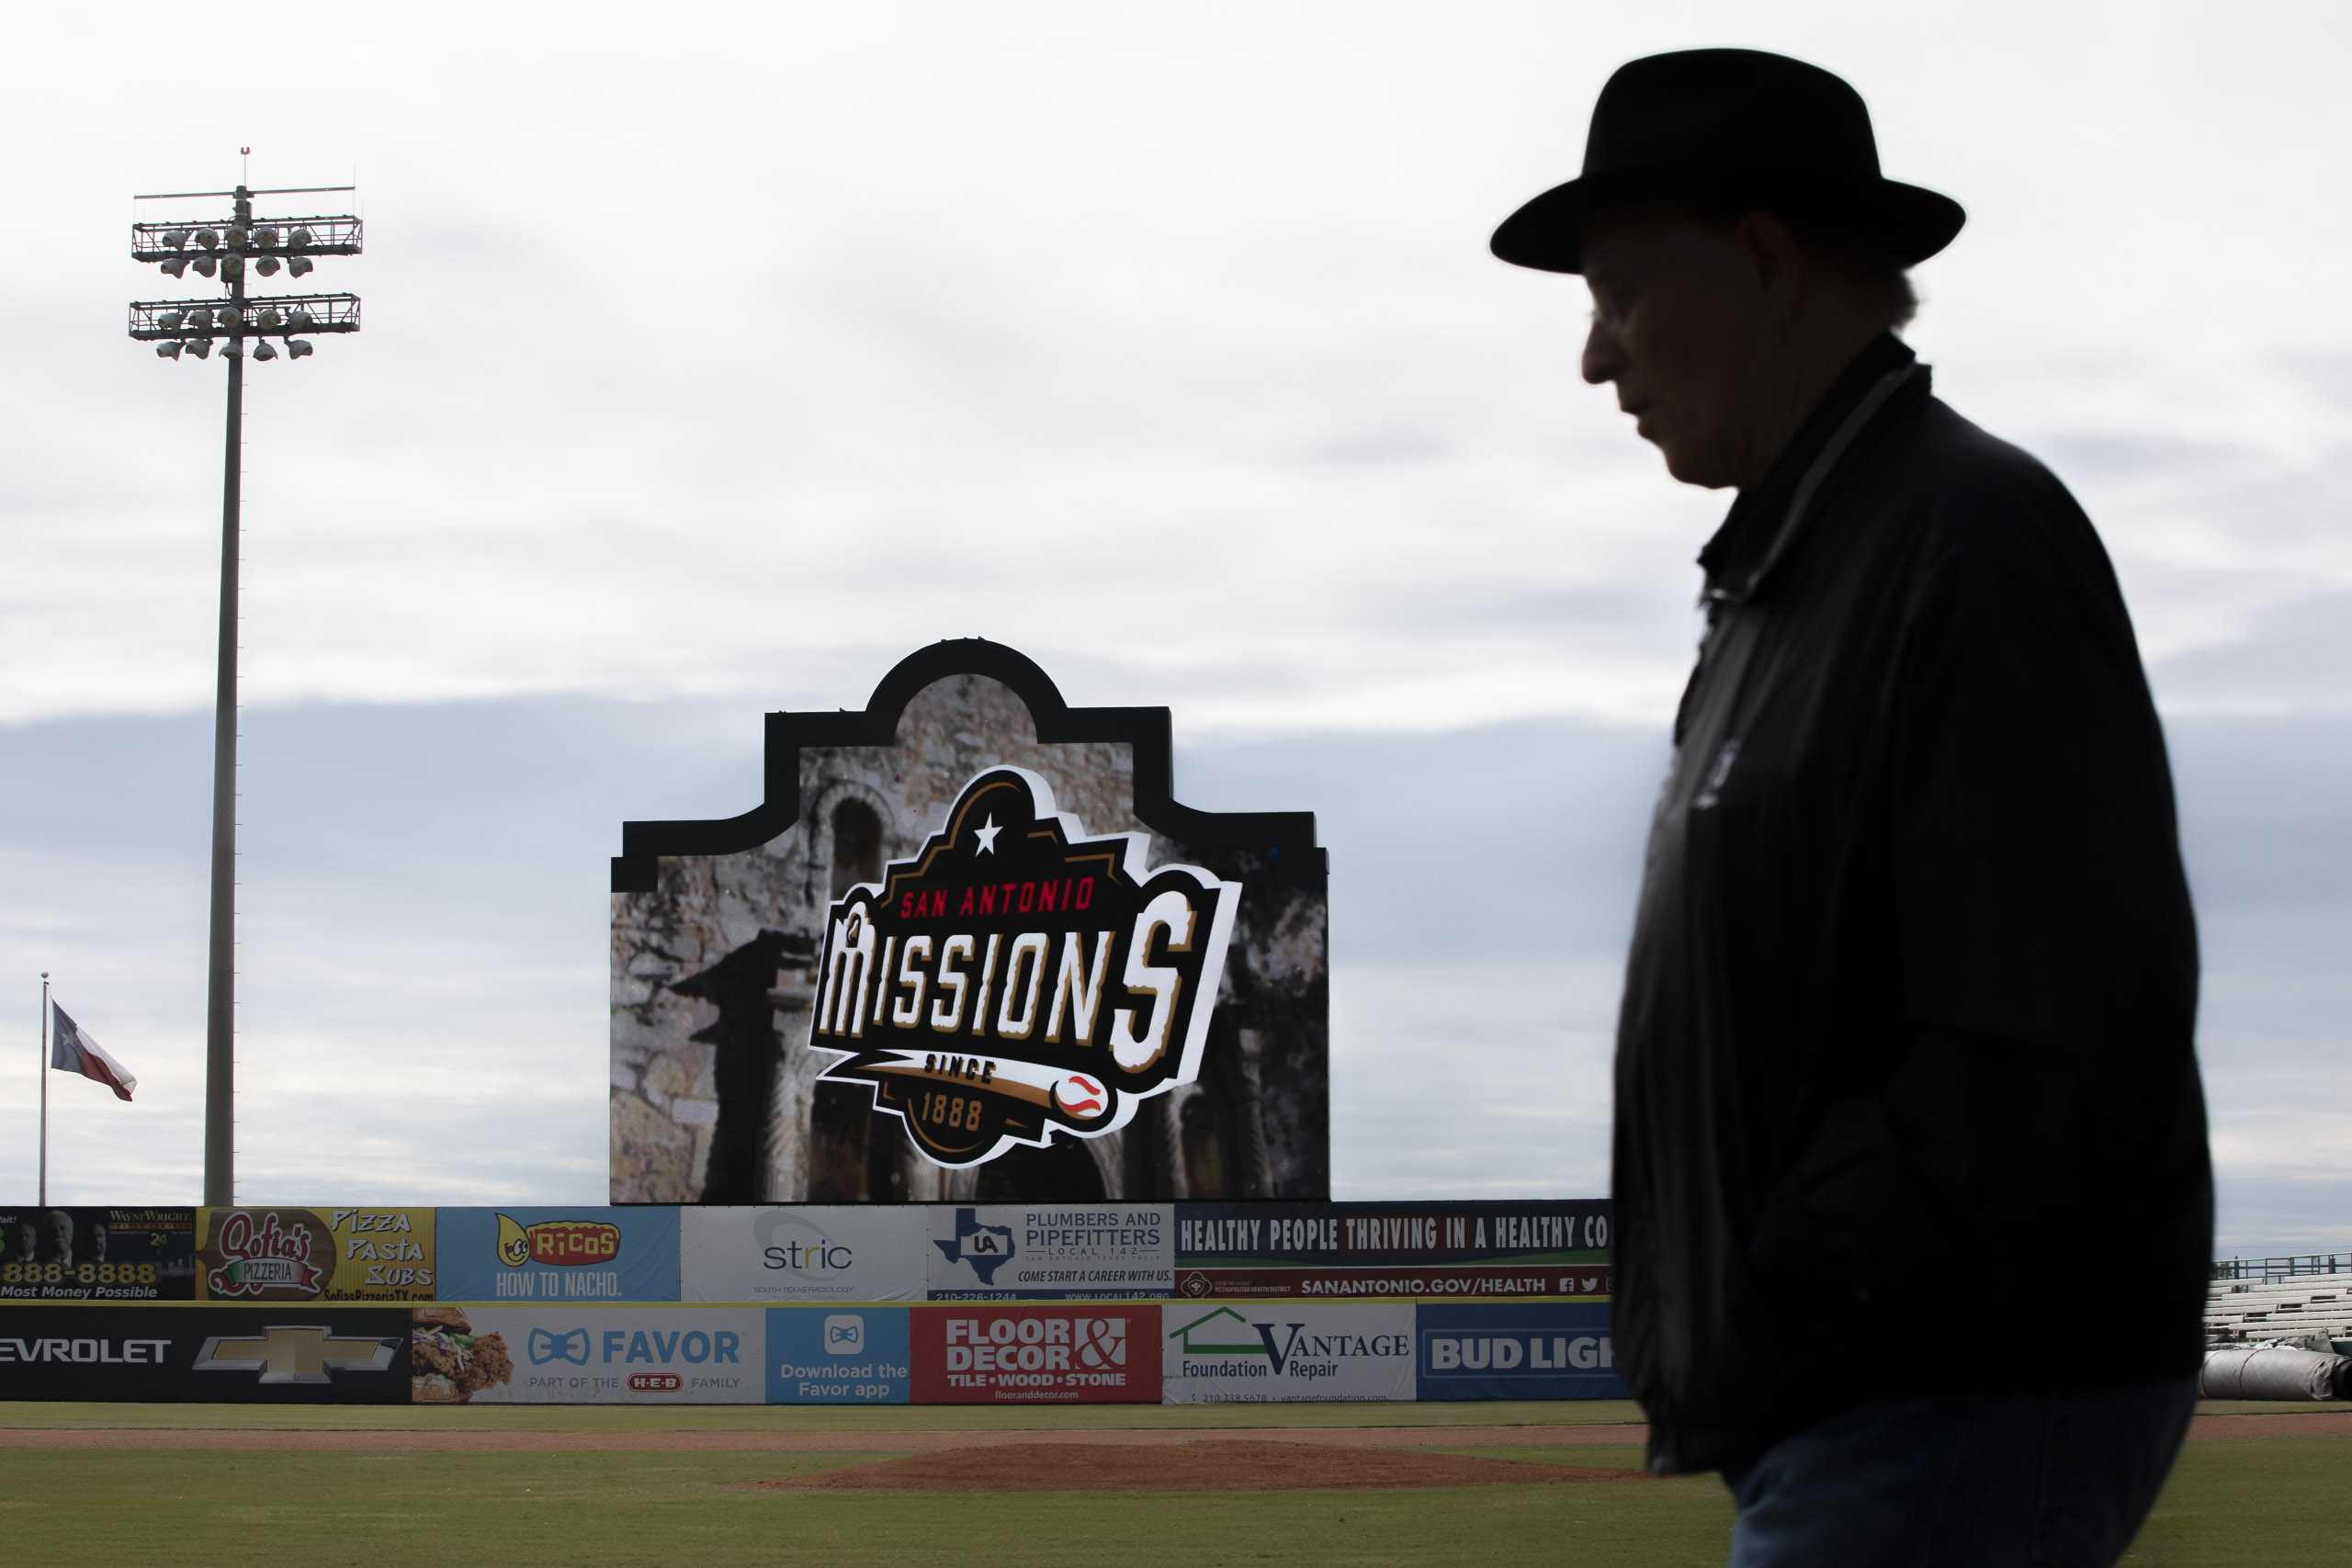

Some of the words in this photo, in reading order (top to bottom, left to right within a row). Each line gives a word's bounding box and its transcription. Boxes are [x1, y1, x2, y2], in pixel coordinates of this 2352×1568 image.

[900, 887, 947, 918] SAN
[960, 876, 1095, 916] ANTONIO
[819, 890, 1197, 1074] MISSIONS
[923, 1054, 997, 1085] SINCE
[922, 1091, 982, 1132] 1888
[0, 1215, 17, 1224] ait!
[1026, 1213, 1119, 1226] PLUMBERS
[1125, 1213, 1161, 1226] AND
[220, 1212, 311, 1261] Sofia's
[1026, 1228, 1160, 1247] PIPEFITTERS
[1181, 1219, 1261, 1251] HEALTHY
[1270, 1218, 1338, 1250] PEOPLE
[1346, 1217, 1437, 1249] THRIVING
[1445, 1217, 1465, 1249] IN
[1475, 1217, 1487, 1248] A
[1496, 1216, 1575, 1248] HEALTHY
[1584, 1215, 1614, 1248] CO
[974, 1235, 999, 1253] UA
[1048, 1247, 1097, 1256] LOCAL
[763, 1239, 853, 1269] stric
[243, 1262, 292, 1280] PIZZERIA
[1018, 1270, 1046, 1282] COME
[1047, 1270, 1078, 1281] START
[1079, 1270, 1086, 1281] A
[1088, 1270, 1125, 1281] CAREER
[1127, 1270, 1154, 1281] WITH
[1156, 1269, 1172, 1281] US.
[0, 1286, 38, 1297] Most
[41, 1286, 92, 1300] Money
[96, 1286, 158, 1297] Possible
[496, 1272, 535, 1297] HOW
[539, 1272, 559, 1297] TO
[565, 1271, 622, 1297] NACHO.
[1301, 1278, 1545, 1294] SANANTONIO.GOV/HEALTH
[323, 1289, 434, 1302] SofiasPizzeriaTXcom
[946, 1318, 1070, 1345] FLOOR
[603, 1330, 741, 1364] FAVOR
[1251, 1323, 1409, 1376] VANTAGE
[1431, 1337, 1523, 1370] BUD
[946, 1345, 1070, 1371] DECOR
[781, 1363, 872, 1379] Download
[878, 1363, 908, 1378] the
[1182, 1359, 1267, 1377] Foundation
[1289, 1359, 1339, 1381] Repair
[529, 1377, 565, 1388] PART
[569, 1377, 588, 1388] OF
[594, 1377, 619, 1388] THE
[691, 1377, 741, 1388] FAMILY
[947, 1374, 987, 1387] TILE
[998, 1373, 1055, 1387] WOOD
[1066, 1373, 1126, 1386] STONE
[798, 1382, 850, 1396] Favor
[854, 1384, 889, 1399] app
[995, 1390, 1079, 1399] flooranddecor.com
